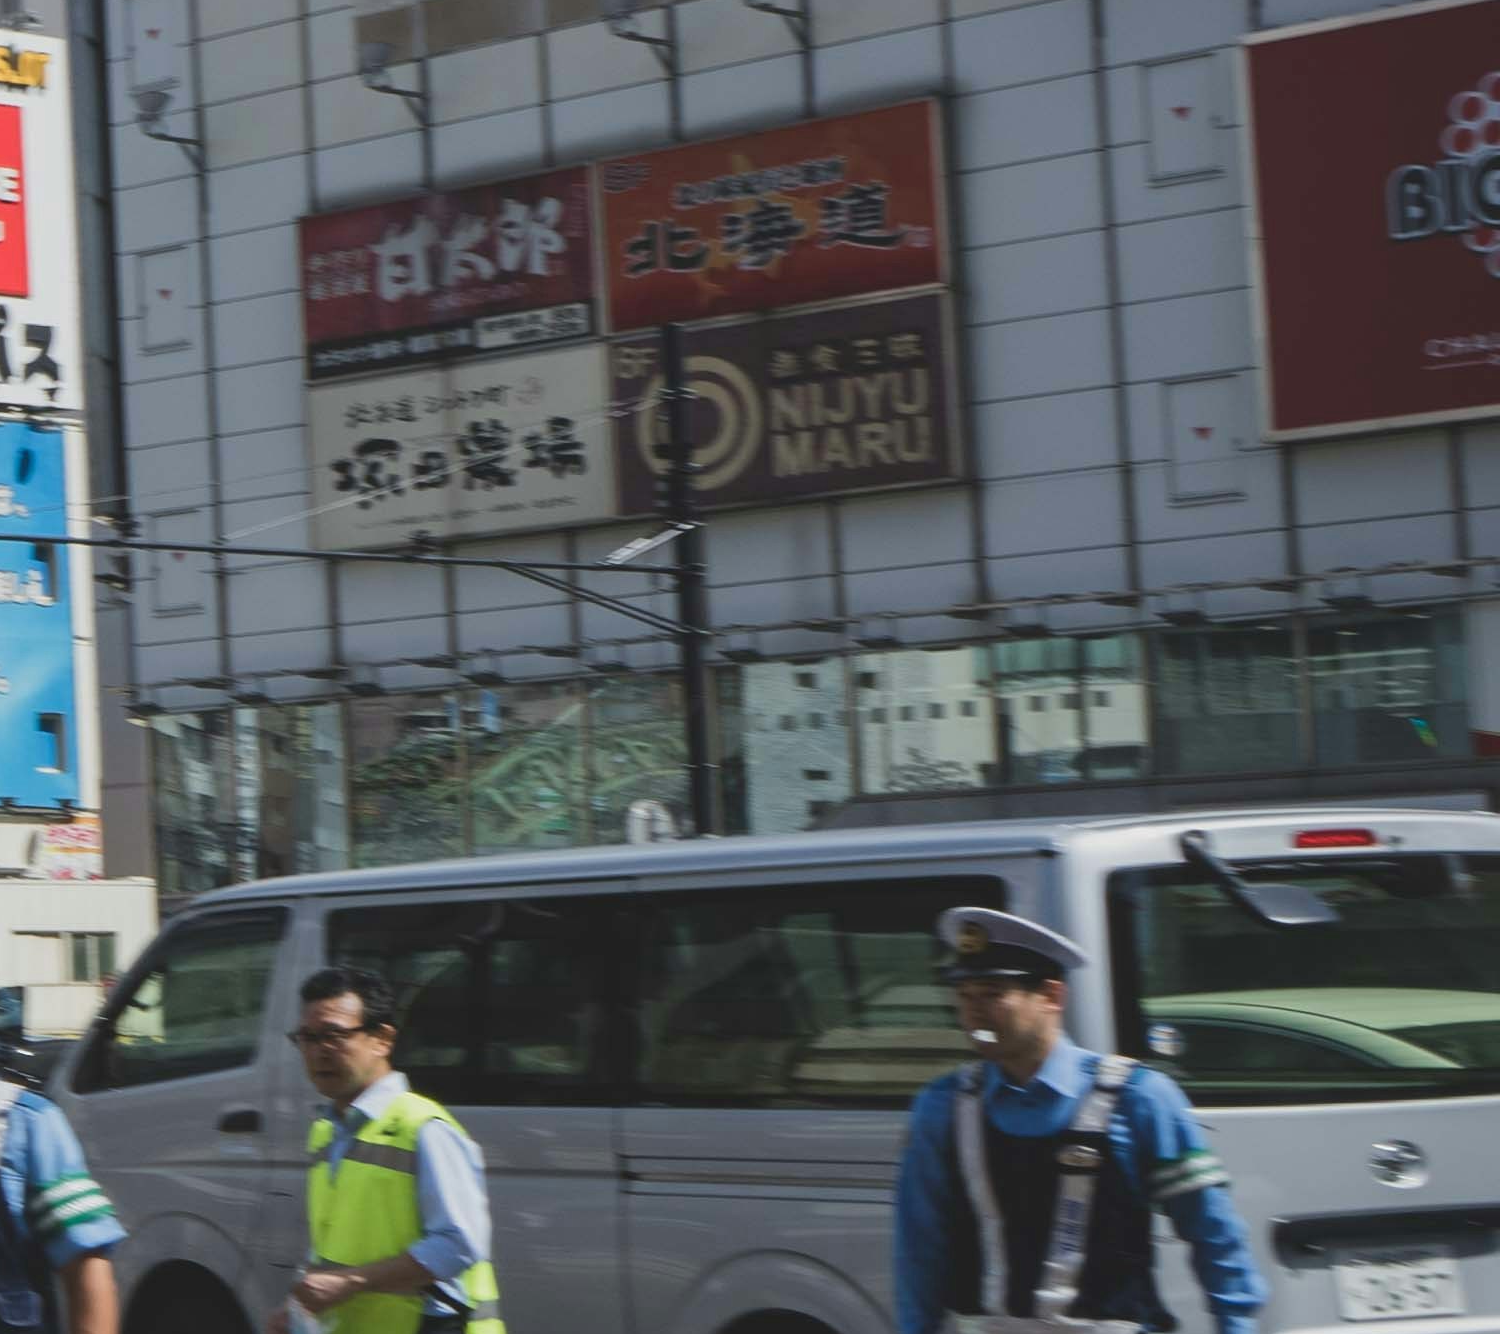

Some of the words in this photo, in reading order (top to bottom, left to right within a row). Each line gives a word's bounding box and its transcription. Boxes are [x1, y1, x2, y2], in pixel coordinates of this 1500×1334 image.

[368, 197, 568, 303] 甘太郎
[620, 179, 907, 281] 北海道
[769, 368, 930, 431] NIJYU
[770, 417, 934, 478] MARU
